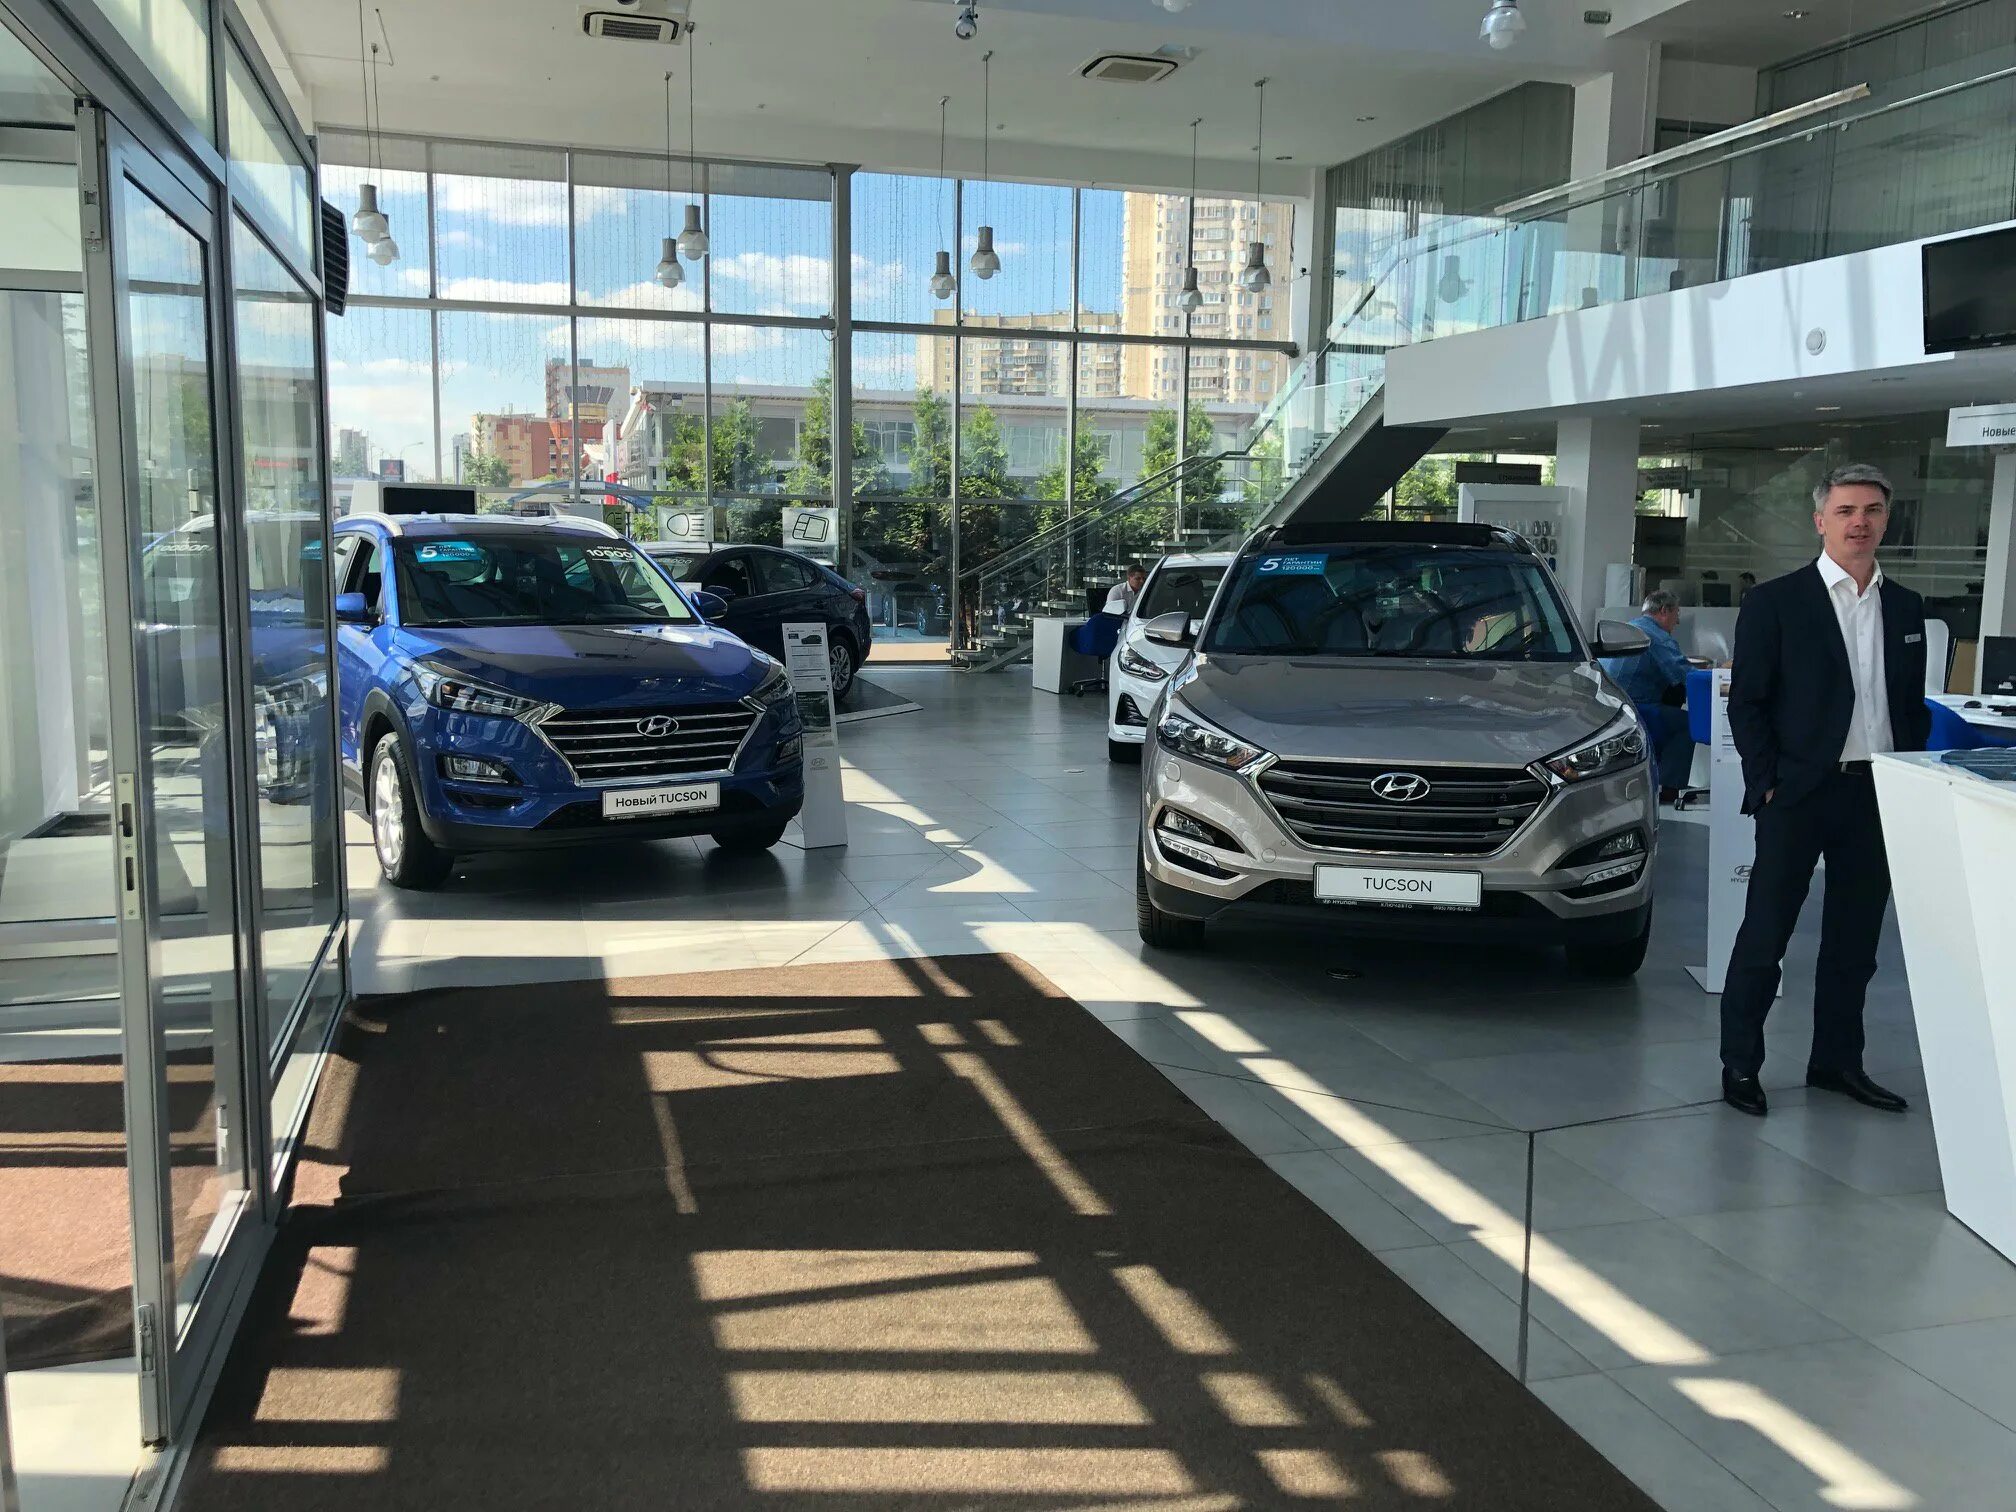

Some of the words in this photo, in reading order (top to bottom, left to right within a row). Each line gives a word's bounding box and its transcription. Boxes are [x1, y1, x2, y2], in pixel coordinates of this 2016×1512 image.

[1982, 426, 2016, 437] Новые
[421, 546, 437, 558] 5
[1259, 557, 1282, 571] 5
[616, 795, 657, 807] Новый
[659, 790, 707, 803] TUCSON
[1363, 877, 1432, 892] TUCSON
